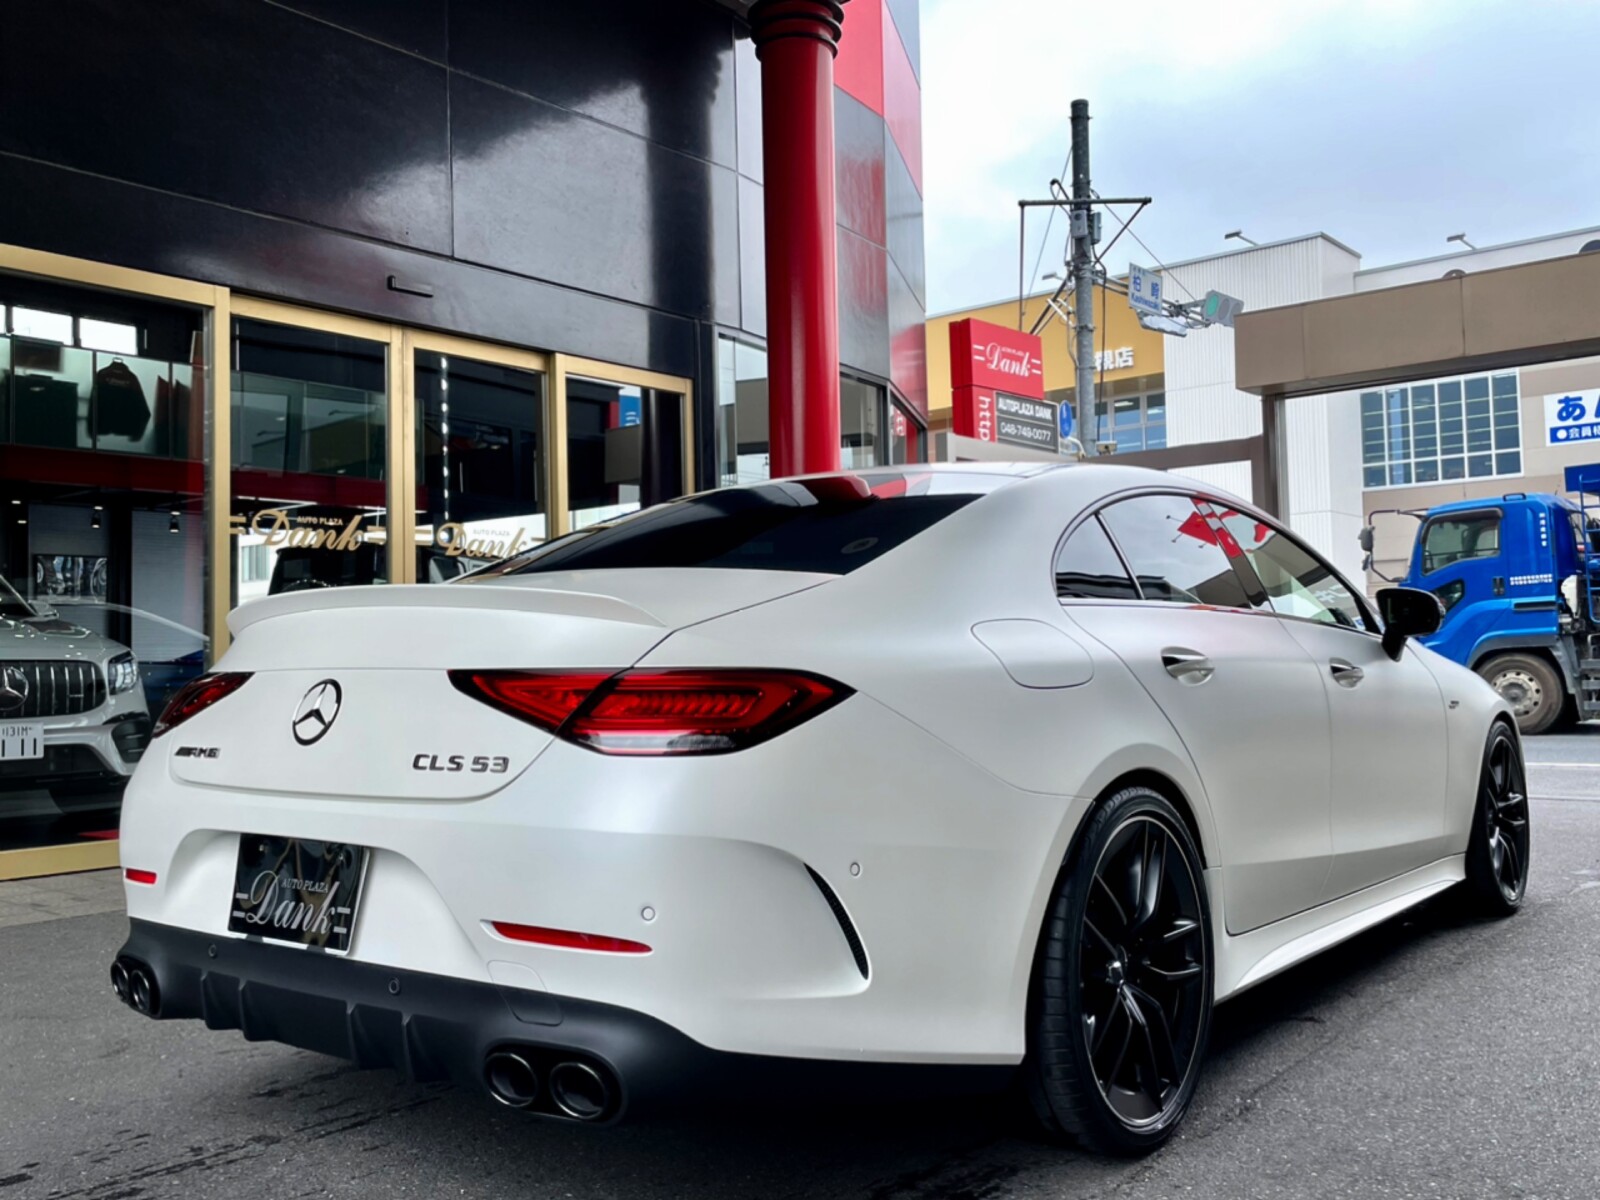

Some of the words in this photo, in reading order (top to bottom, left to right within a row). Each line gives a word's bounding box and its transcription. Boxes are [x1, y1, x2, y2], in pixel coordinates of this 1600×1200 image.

[986, 342, 1031, 377] Dank
[978, 396, 991, 441] http
[1035, 405, 1052, 420] DANK
[252, 509, 365, 552] Dank
[297, 516, 318, 524] AUTO
[320, 518, 343, 526] PLAZA
[437, 522, 527, 559] Dank
[186, 747, 221, 759] AMG
[412, 754, 465, 771] CLS
[470, 756, 509, 773] 53
[282, 878, 302, 889] AUTO
[304, 881, 329, 893] PLAZA
[246, 870, 340, 935] Dank
